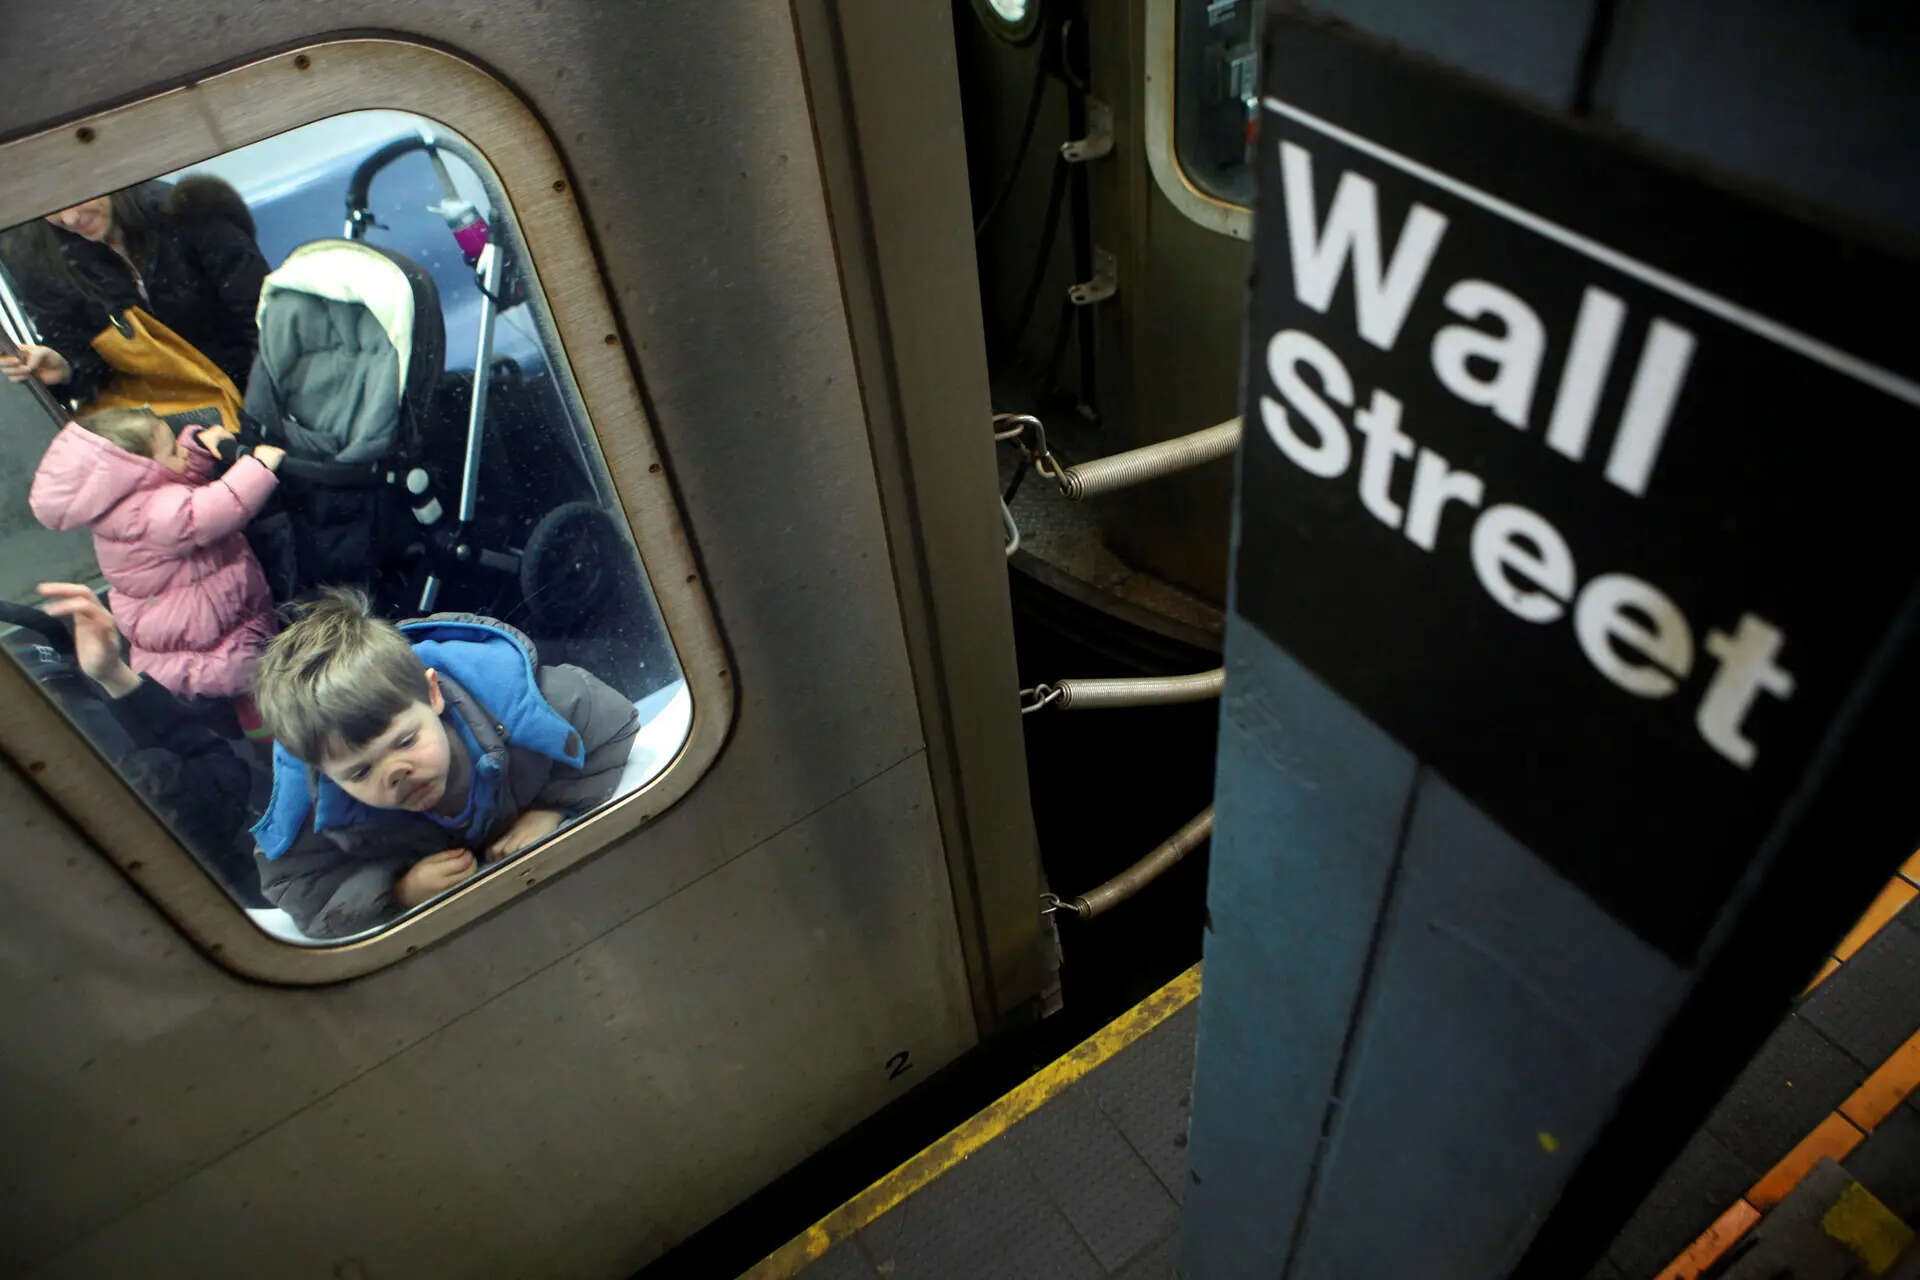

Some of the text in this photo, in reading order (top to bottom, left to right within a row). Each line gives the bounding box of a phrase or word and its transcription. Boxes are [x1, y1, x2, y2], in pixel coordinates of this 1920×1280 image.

[1278, 140, 1696, 496] Wall
[1259, 328, 1793, 767] Street
[885, 1050, 913, 1081] 2
